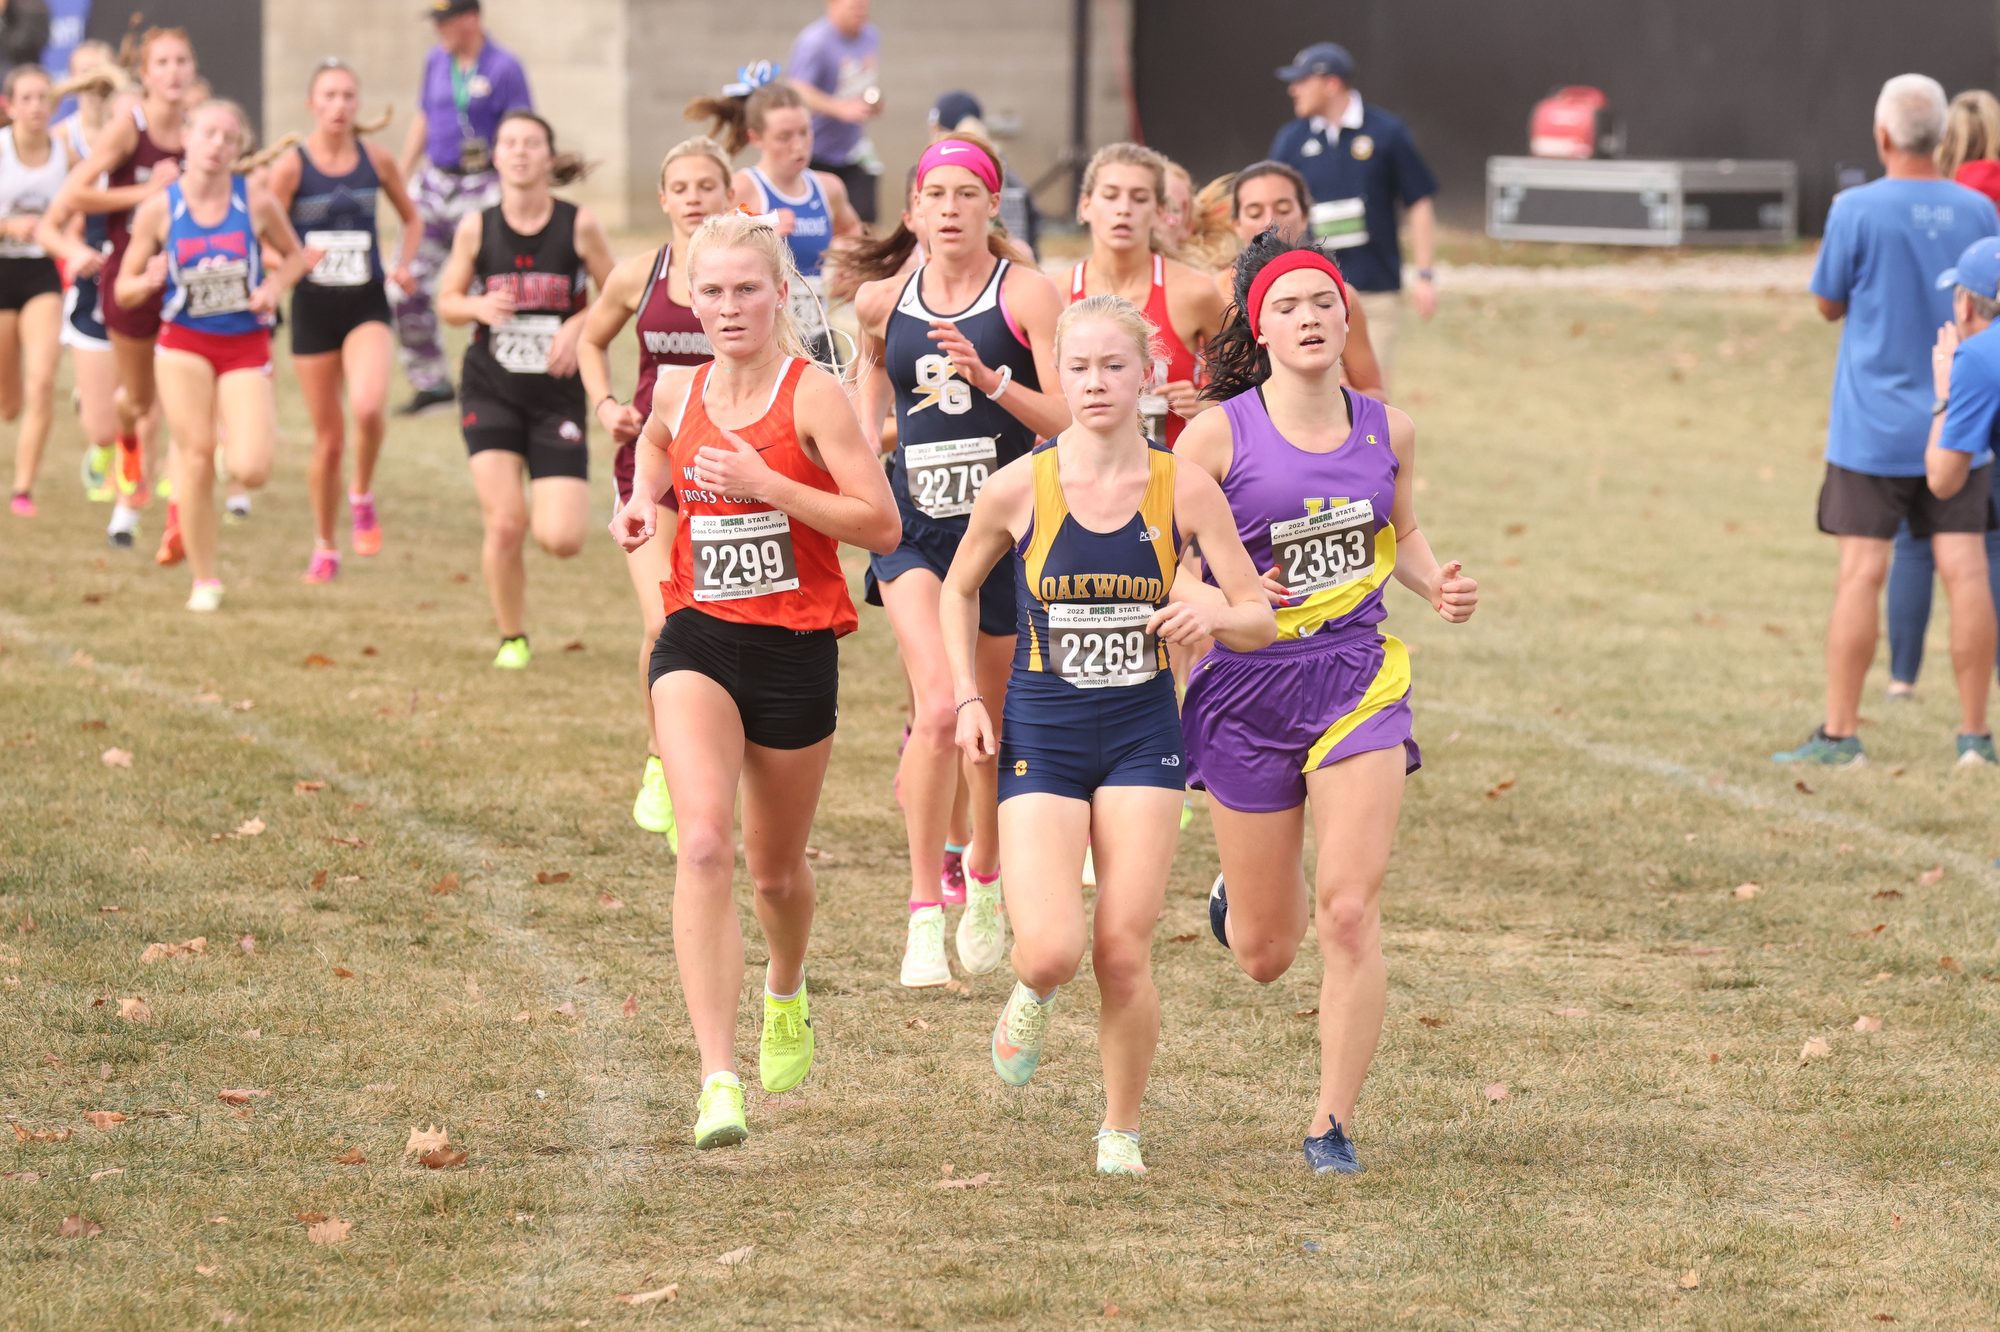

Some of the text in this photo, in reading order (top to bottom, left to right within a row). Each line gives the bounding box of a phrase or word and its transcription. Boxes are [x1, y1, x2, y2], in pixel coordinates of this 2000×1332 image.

[947, 447, 994, 458] Championships
[917, 463, 989, 506] 2279
[692, 521, 787, 535] Cross Country Championships
[720, 517, 745, 527] OHSAA
[747, 515, 771, 524] STATE
[1273, 511, 1372, 540] Cross Country Championships
[1288, 507, 1357, 530] 2022 OHSAA STATE
[701, 540, 785, 586] 2299
[1284, 530, 1366, 584] 2353
[1042, 574, 1162, 601] OAKWOOD
[1089, 606, 1115, 615] OHSAA
[1061, 631, 1144, 674] 2269
